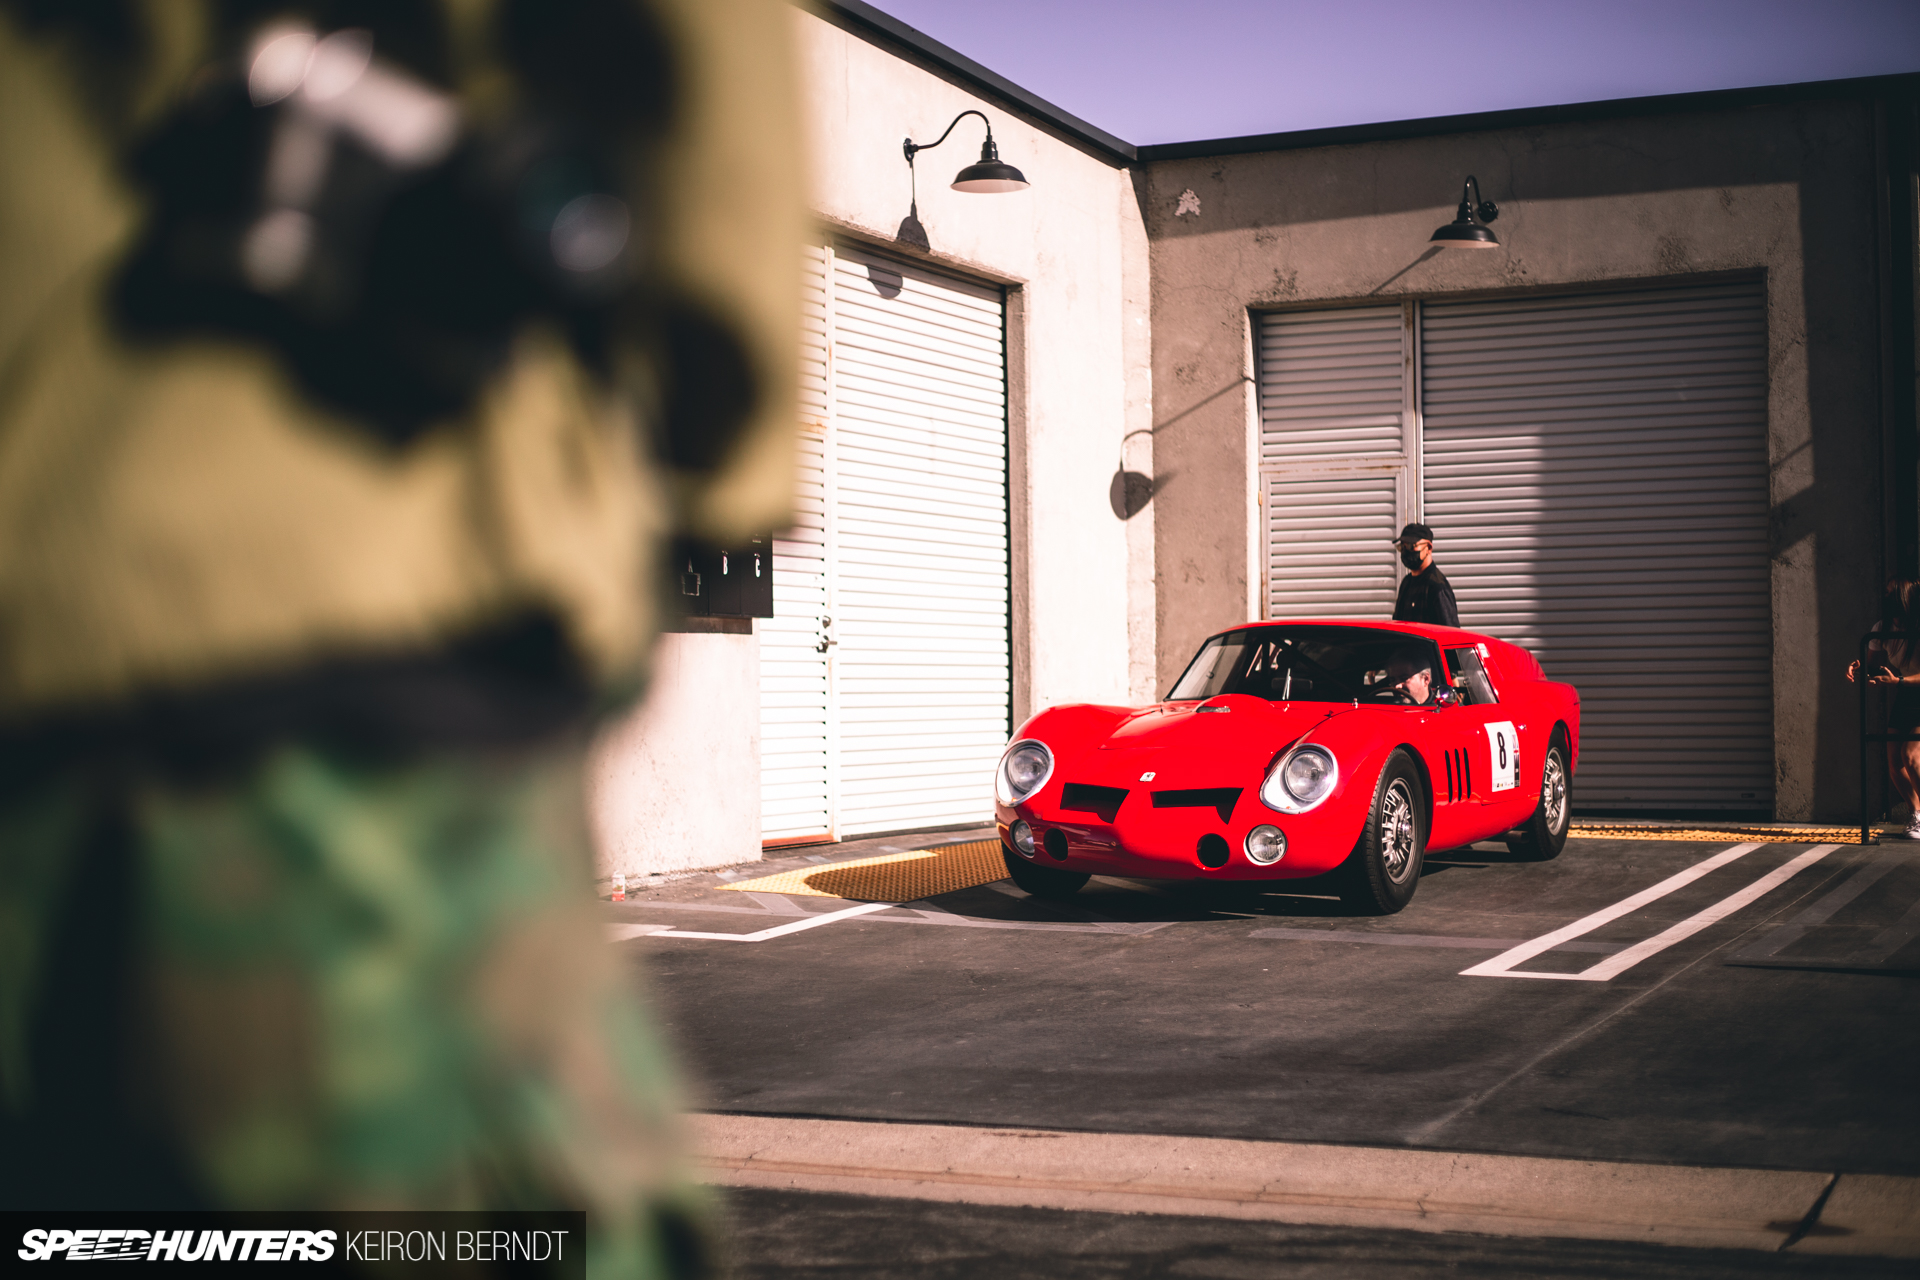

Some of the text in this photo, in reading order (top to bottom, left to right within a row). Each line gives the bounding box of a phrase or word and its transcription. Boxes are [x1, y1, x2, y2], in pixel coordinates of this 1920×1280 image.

[723, 555, 729, 575] B
[755, 558, 761, 578] C
[1497, 731, 1506, 770] 8
